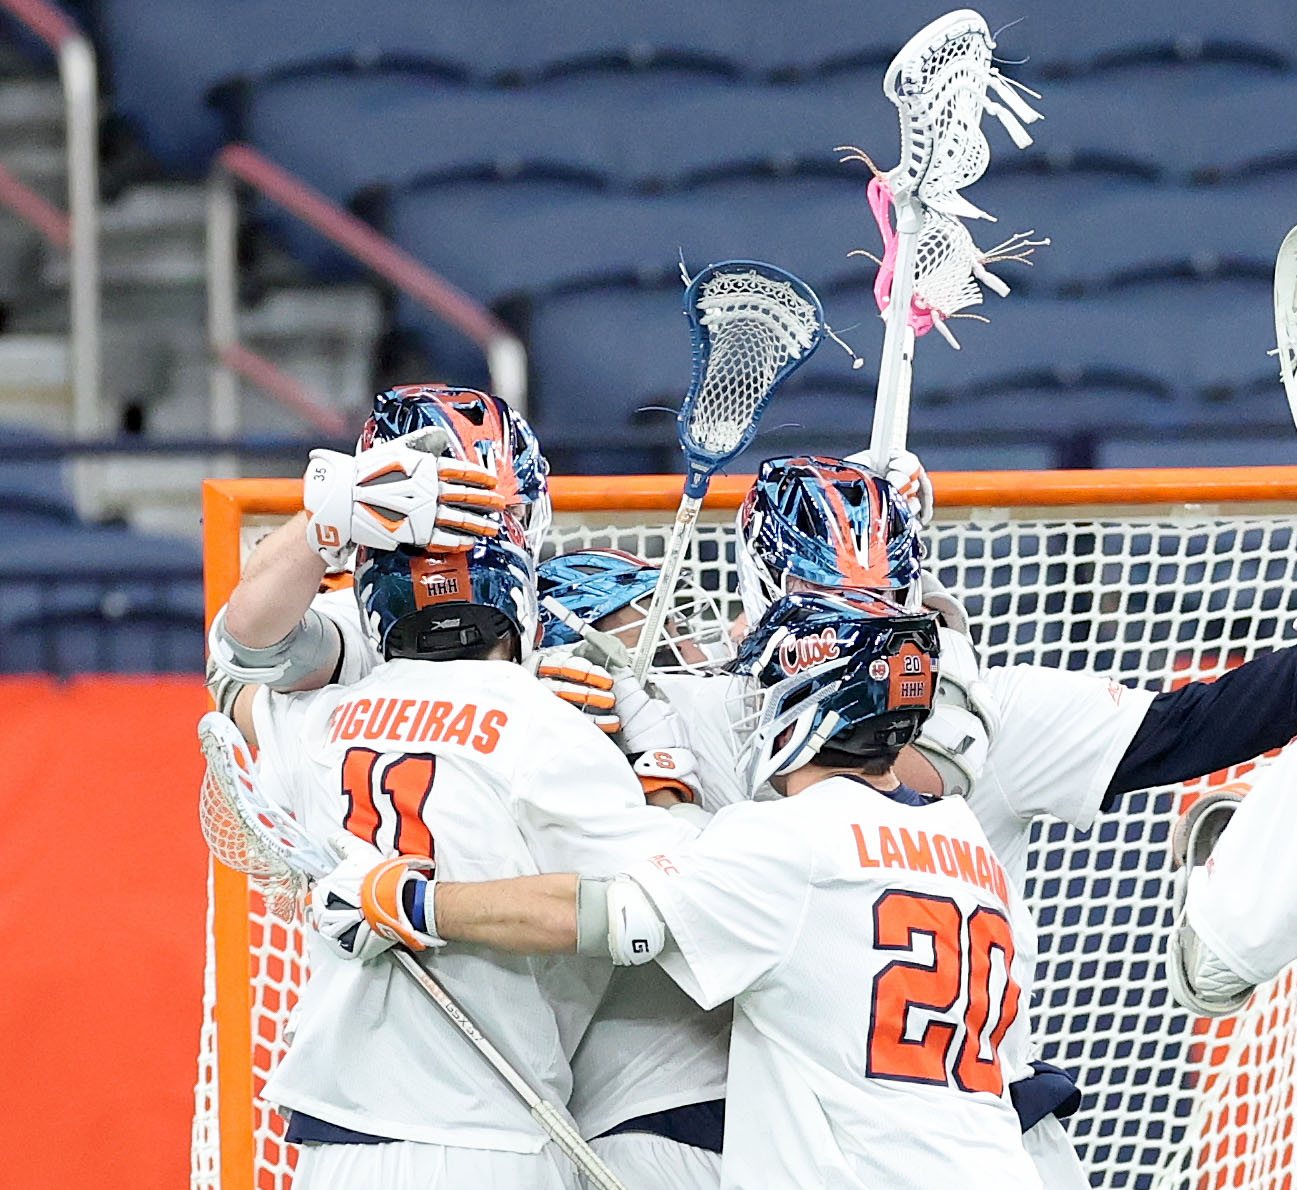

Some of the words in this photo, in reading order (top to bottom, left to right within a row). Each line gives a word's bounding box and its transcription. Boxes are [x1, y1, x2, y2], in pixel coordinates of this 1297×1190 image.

[313, 467, 327, 482] 35
[779, 627, 841, 676] Cuse
[904, 655, 922, 673] 20
[340, 746, 437, 881] 11
[865, 888, 1022, 1099] 20
